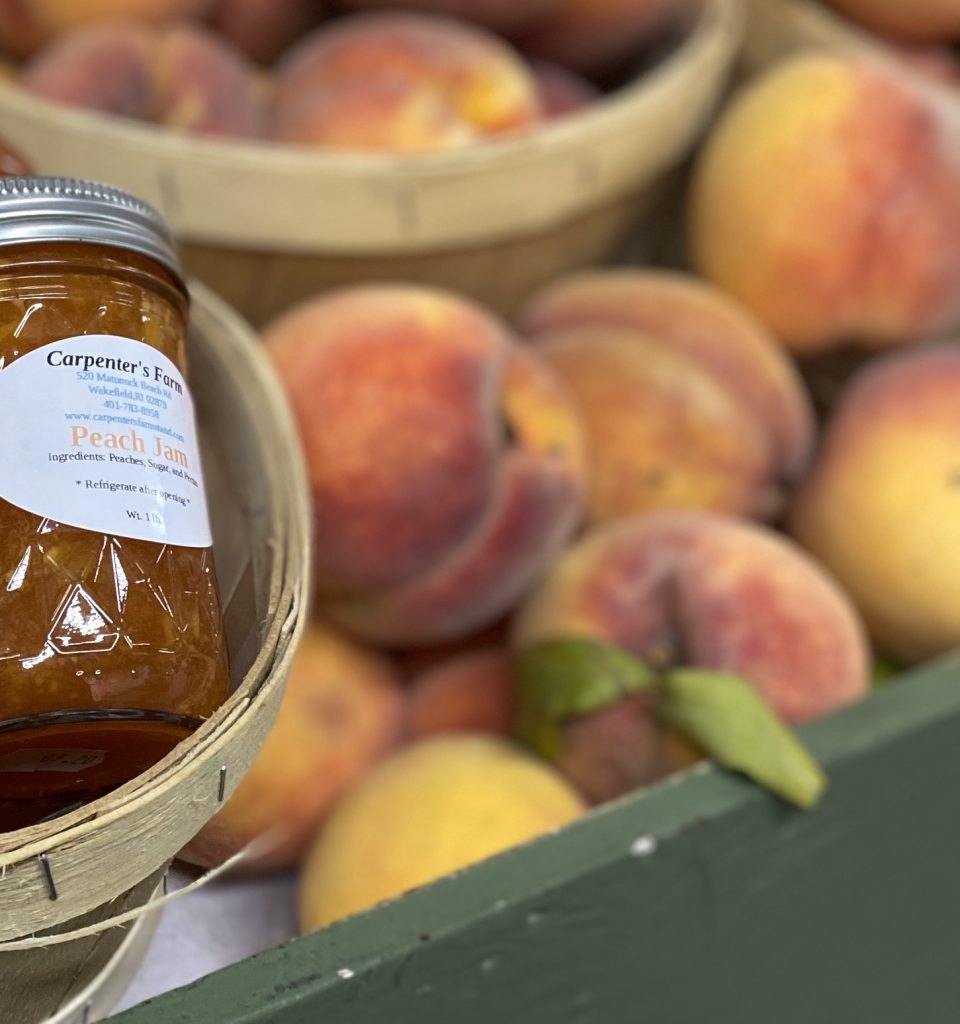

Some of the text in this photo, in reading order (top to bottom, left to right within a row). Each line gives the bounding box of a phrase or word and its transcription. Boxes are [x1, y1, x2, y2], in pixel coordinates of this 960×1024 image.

[46, 350, 183, 396] Carpenter's Farm
[76, 372, 95, 381] 520
[70, 426, 188, 468] Peach Jam
[48, 452, 106, 463] Ingredients:
[109, 453, 147, 467] Peaches,
[85, 479, 137, 492] Refrigerate
[139, 485, 158, 496] after
